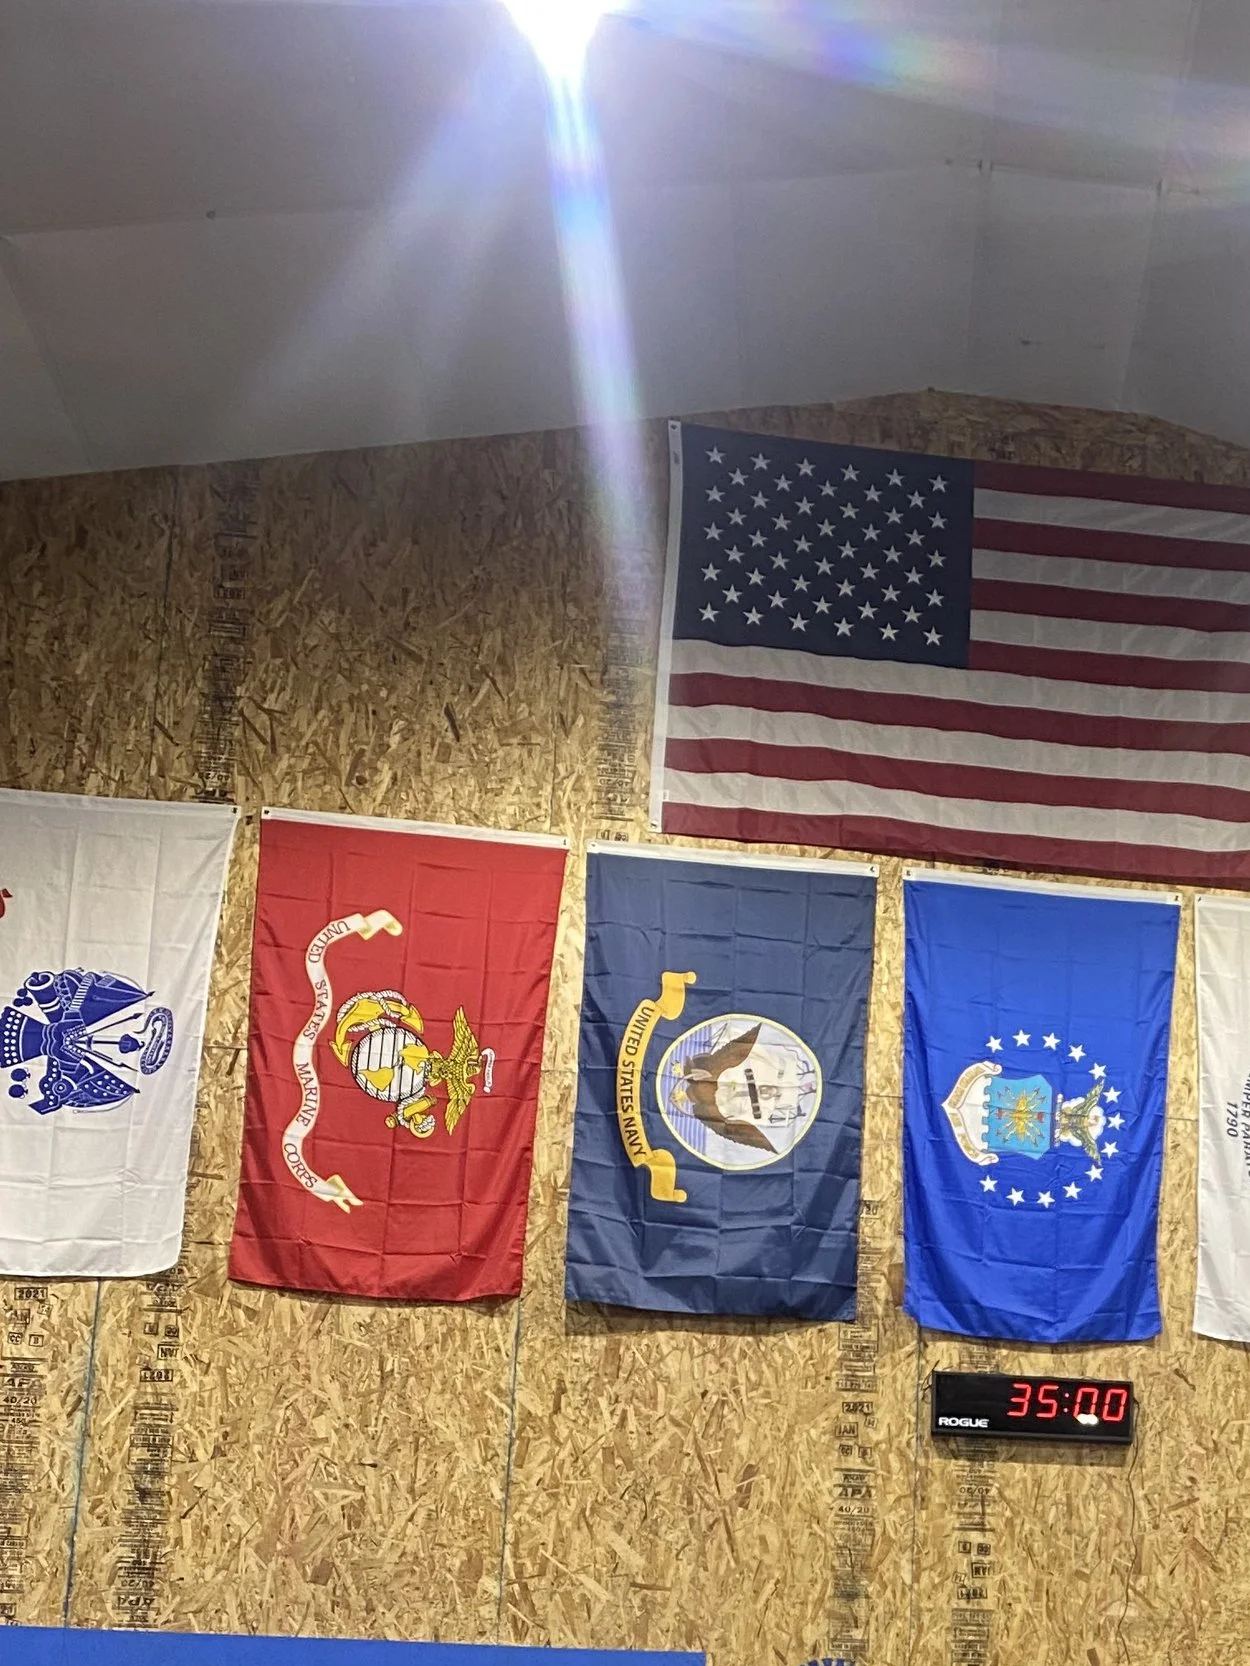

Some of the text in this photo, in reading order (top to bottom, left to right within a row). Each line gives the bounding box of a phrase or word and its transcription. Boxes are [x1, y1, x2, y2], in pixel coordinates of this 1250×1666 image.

[284, 920, 351, 1188] UNITED STATES MARINE CORPS
[619, 1006, 655, 1156] UNITED STATES NAVY
[1226, 1101, 1239, 1138] 1790
[16, 1287, 47, 1300] 2021
[1007, 1383, 1128, 1422] 35:00
[938, 1416, 990, 1428] ROGUE
